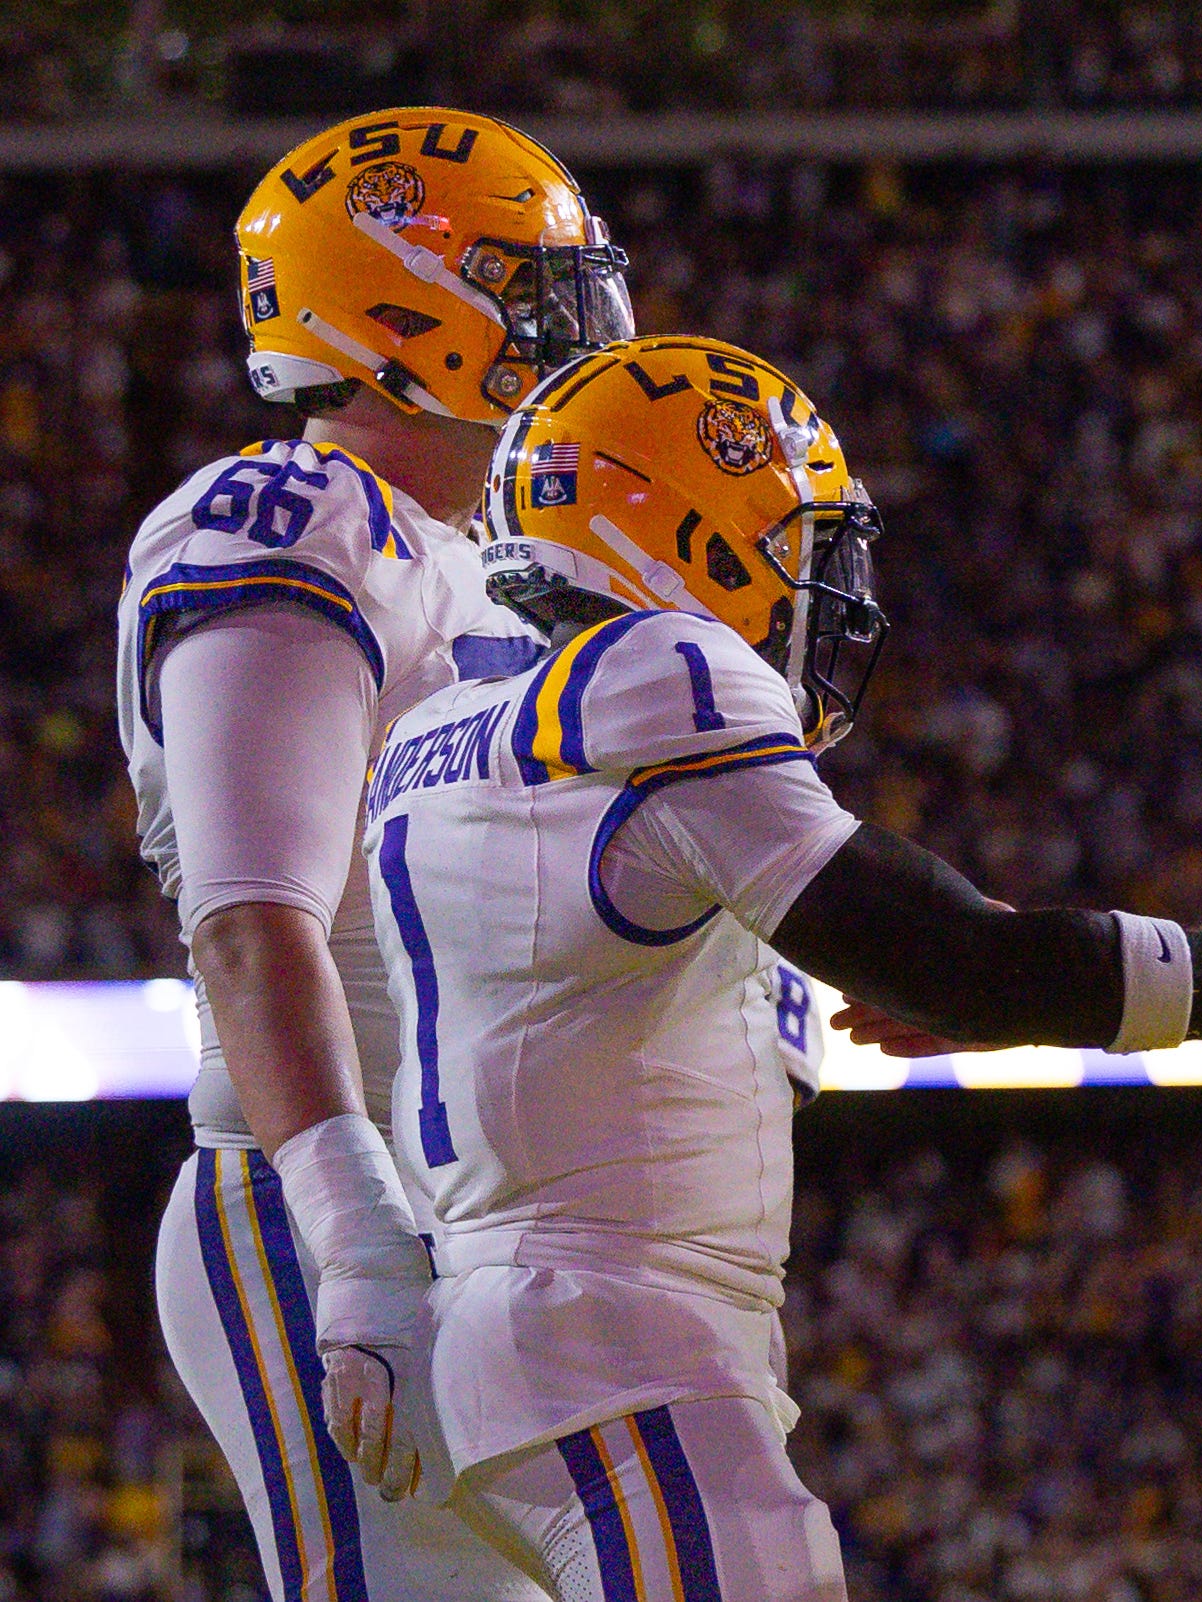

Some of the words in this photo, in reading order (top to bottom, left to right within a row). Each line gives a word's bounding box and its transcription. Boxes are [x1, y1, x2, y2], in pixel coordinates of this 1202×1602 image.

[279, 120, 479, 205] LSU
[623, 352, 817, 448] LSU
[192, 460, 329, 548] 66
[675, 641, 726, 733] 1
[368, 700, 511, 823] ANDERSON
[379, 813, 459, 1168] 1
